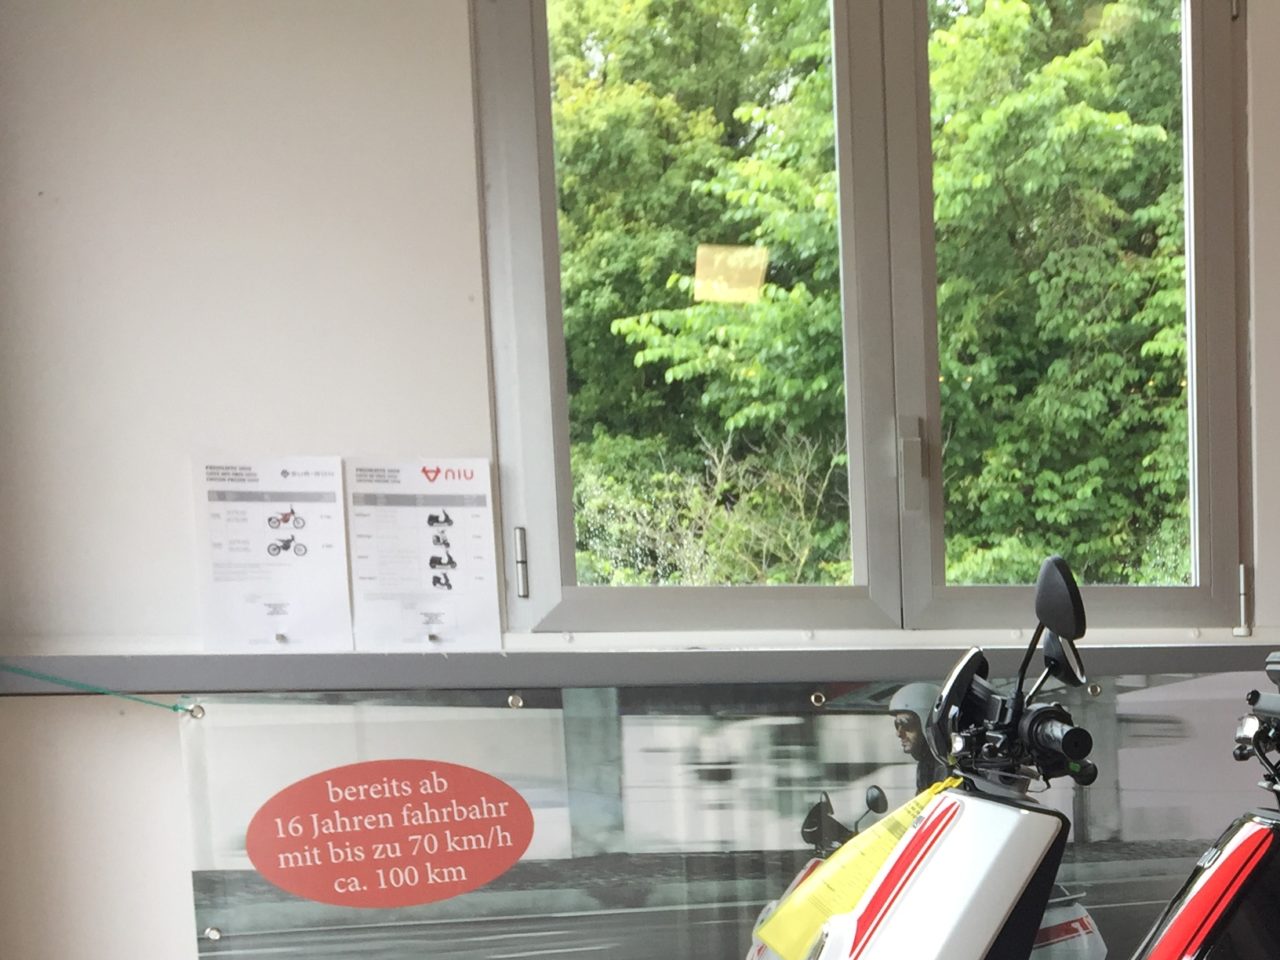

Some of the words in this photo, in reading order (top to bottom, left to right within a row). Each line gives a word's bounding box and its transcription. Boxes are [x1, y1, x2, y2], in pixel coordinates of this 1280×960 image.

[326, 778, 411, 803] bereits
[420, 771, 447, 795] ab
[275, 816, 304, 839] 16
[310, 810, 394, 839] Jahren
[401, 797, 509, 826] fahrbahr
[278, 846, 323, 869] mit
[328, 842, 366, 864] bis
[372, 841, 402, 860] zu
[409, 834, 439, 856] 70
[445, 825, 513, 852] km/h
[333, 875, 368, 894] ca.
[376, 866, 419, 889] 100
[426, 863, 467, 884] km
